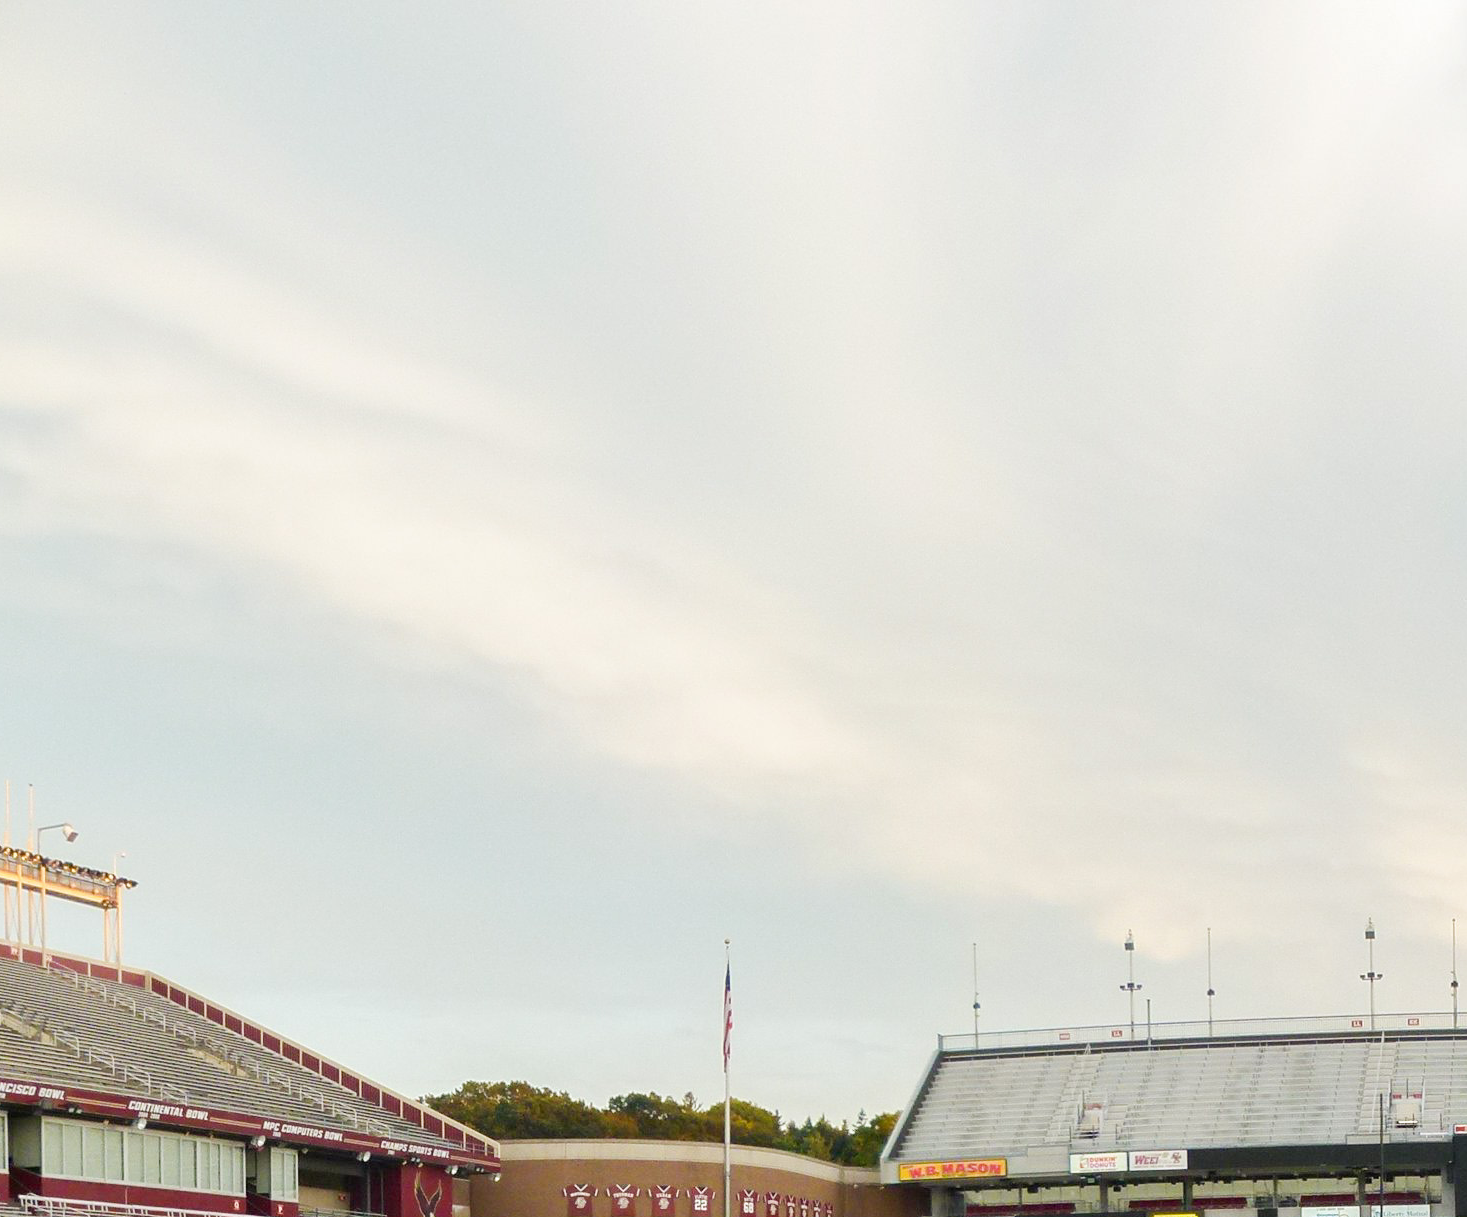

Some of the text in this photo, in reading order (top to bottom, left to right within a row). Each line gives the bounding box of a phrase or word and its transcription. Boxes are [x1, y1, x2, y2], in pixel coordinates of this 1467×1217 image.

[38, 1087, 66, 1100] BOWL
[128, 1100, 183, 1117] CONTINENTAL
[186, 1109, 209, 1120] BOWL
[263, 1120, 280, 1132] MPC
[281, 1124, 323, 1138] COMPUTERS
[324, 1131, 343, 1141] BOWL
[381, 1140, 408, 1152] CHAMPS
[408, 1145, 432, 1156] SPORTS
[942, 1163, 1001, 1174] MASON
[694, 1199, 708, 1211] 22
[743, 1202, 754, 1213] 68
